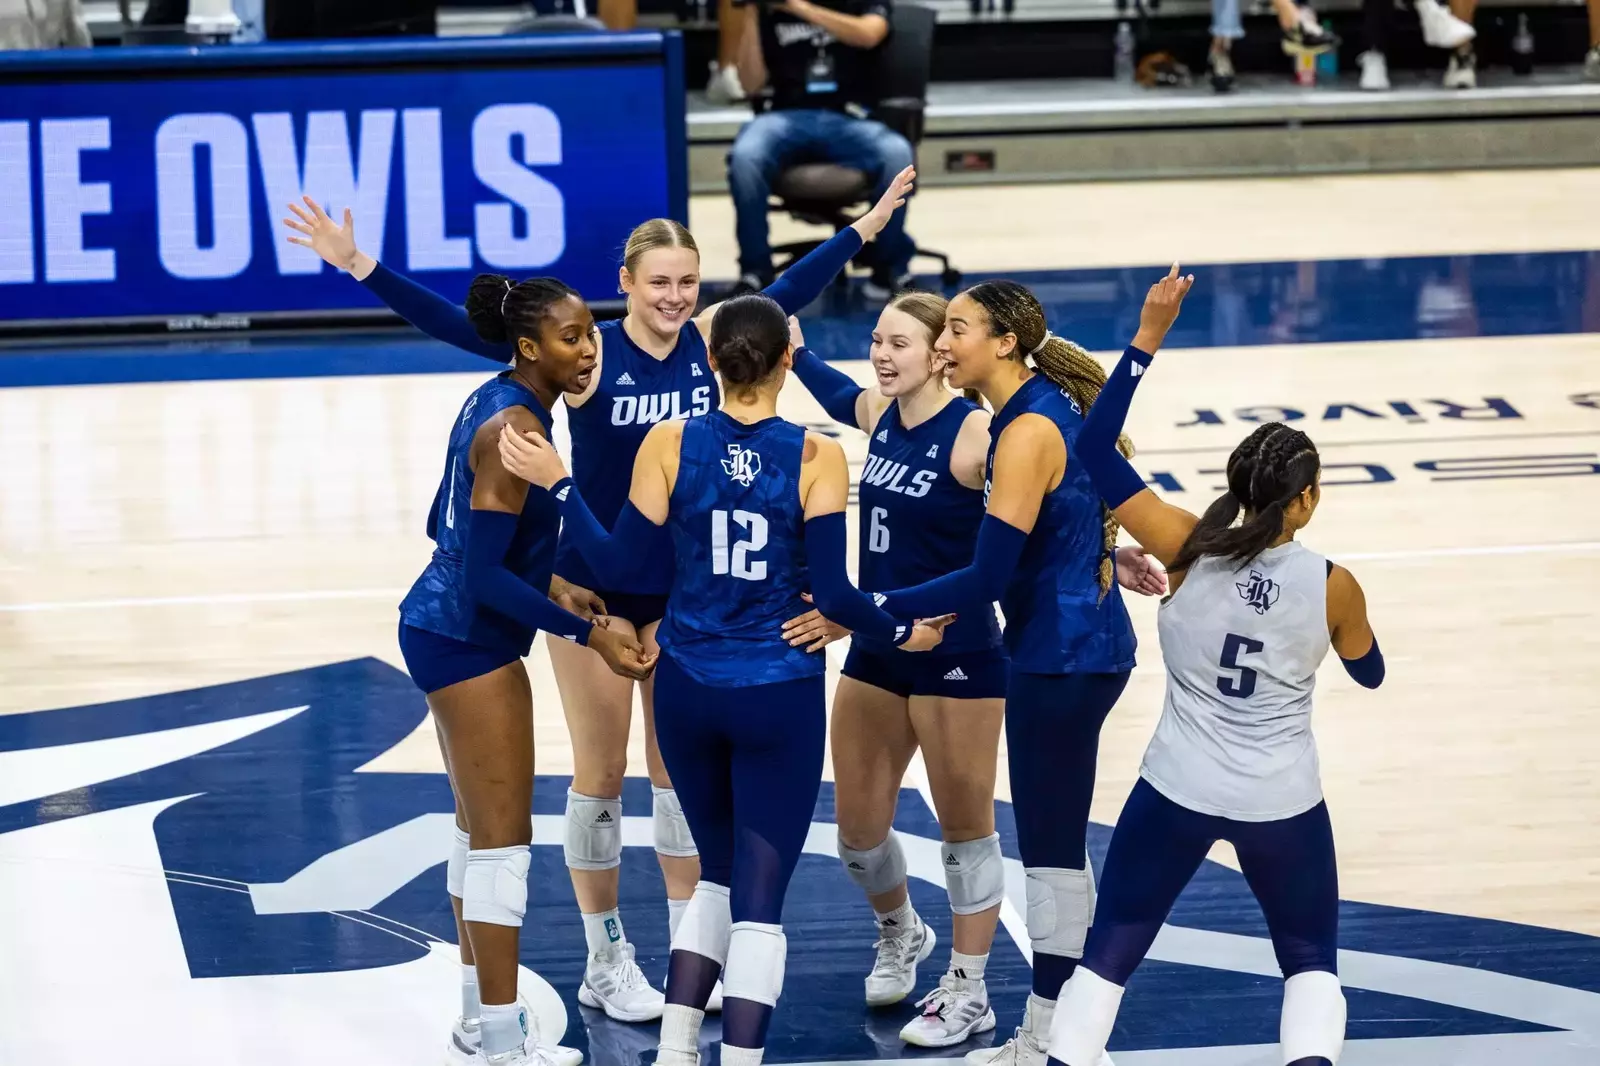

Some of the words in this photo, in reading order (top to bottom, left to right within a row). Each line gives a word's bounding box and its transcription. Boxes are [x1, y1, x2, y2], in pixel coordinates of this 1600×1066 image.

[155, 102, 566, 280] OWLS
[611, 385, 710, 426] OWLS
[1175, 396, 1525, 427] River
[712, 509, 769, 581] 12
[869, 506, 890, 553] 6
[1216, 632, 1265, 699] 5
